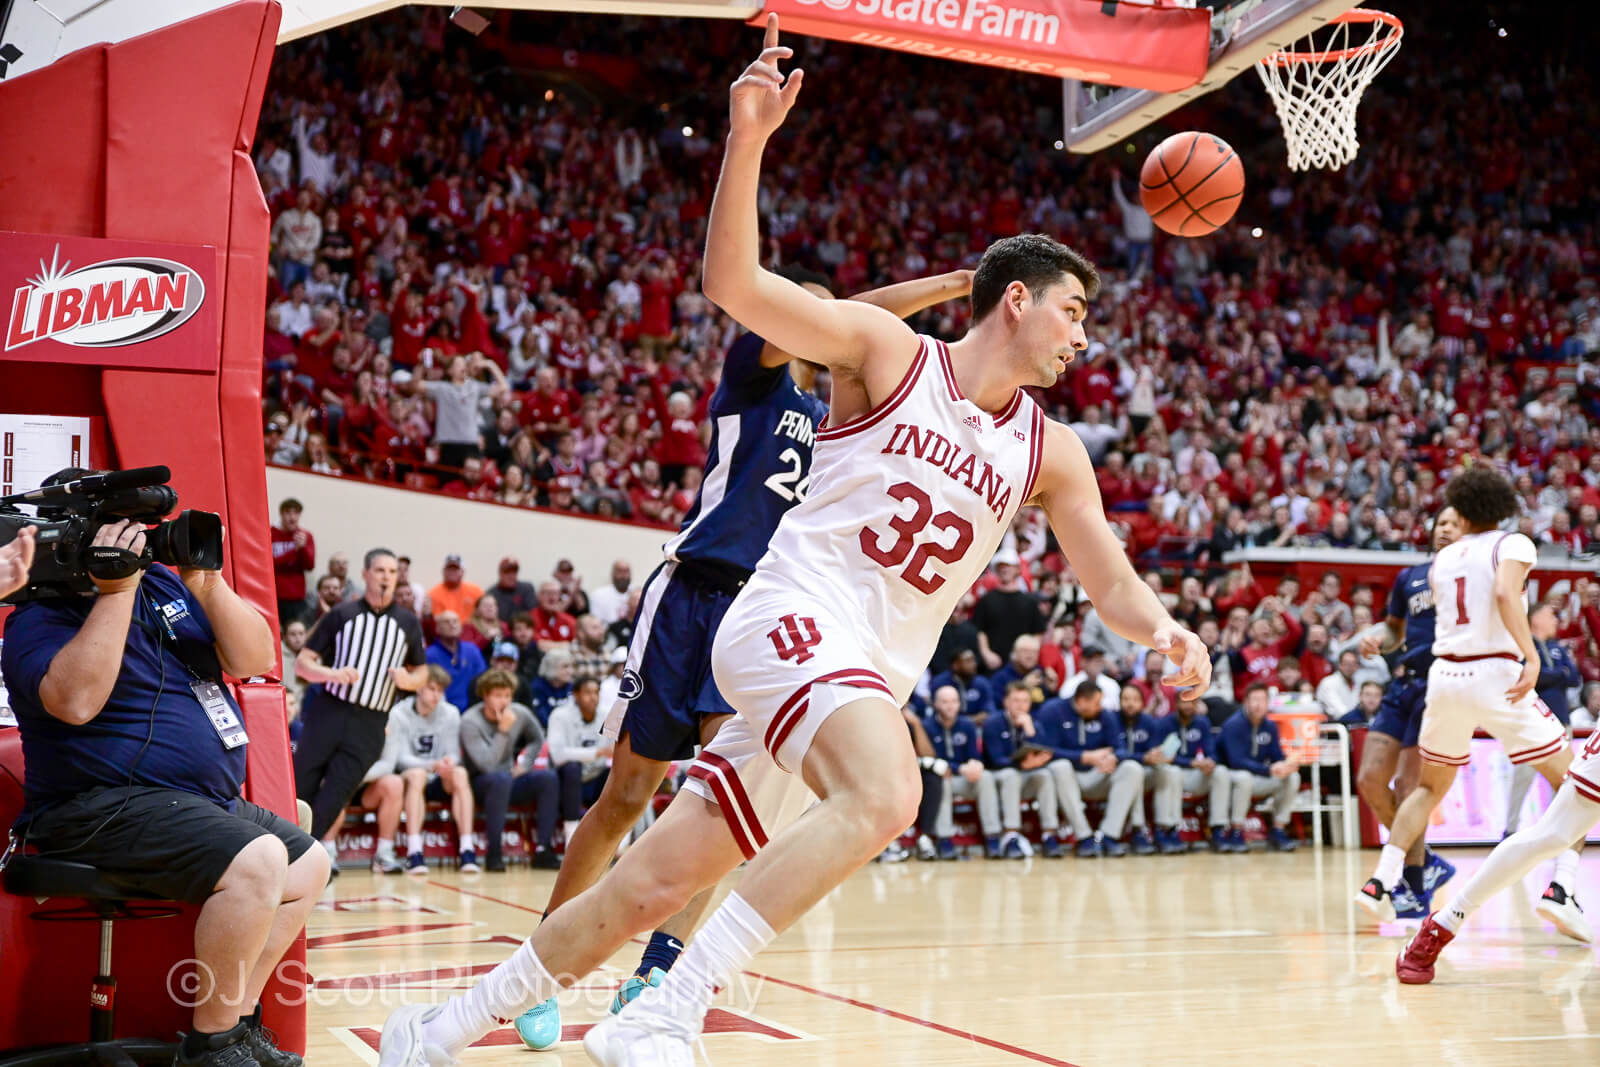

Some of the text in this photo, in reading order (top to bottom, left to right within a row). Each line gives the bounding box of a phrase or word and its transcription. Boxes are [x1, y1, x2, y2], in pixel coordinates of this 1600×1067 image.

[5, 271, 190, 351] LIBMAN
[962, 418, 983, 433] adidas
[881, 424, 1011, 523] INDIANA
[859, 481, 974, 595] 32
[1455, 576, 1470, 625] 1
